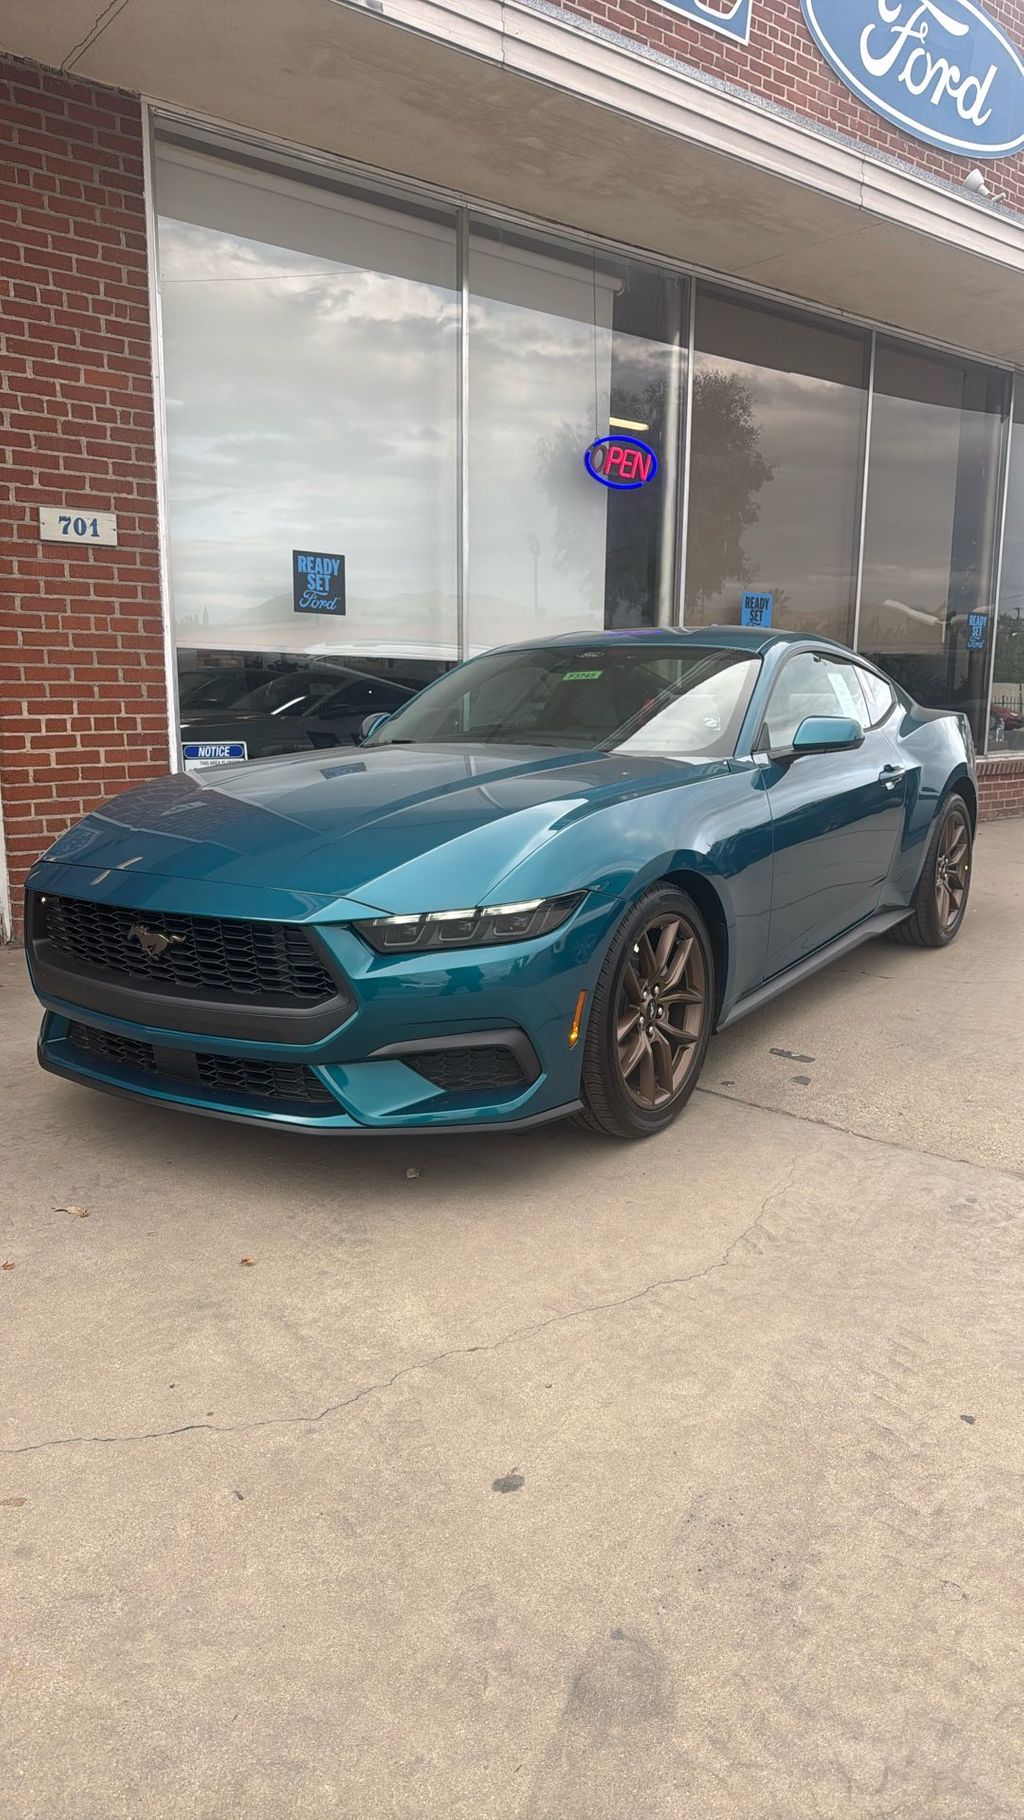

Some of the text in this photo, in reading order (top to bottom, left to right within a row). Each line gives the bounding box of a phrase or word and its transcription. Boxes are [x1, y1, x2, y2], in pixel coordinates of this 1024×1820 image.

[860, 0, 998, 126] Ford
[591, 444, 652, 481] OPEN
[58, 516, 100, 537] 701
[297, 555, 340, 576] READY
[307, 573, 331, 591] SET
[299, 589, 338, 610] Ford
[745, 596, 769, 610] READY
[749, 609, 763, 622] SET
[969, 614, 988, 627] READY
[198, 746, 230, 757] NOTICE
